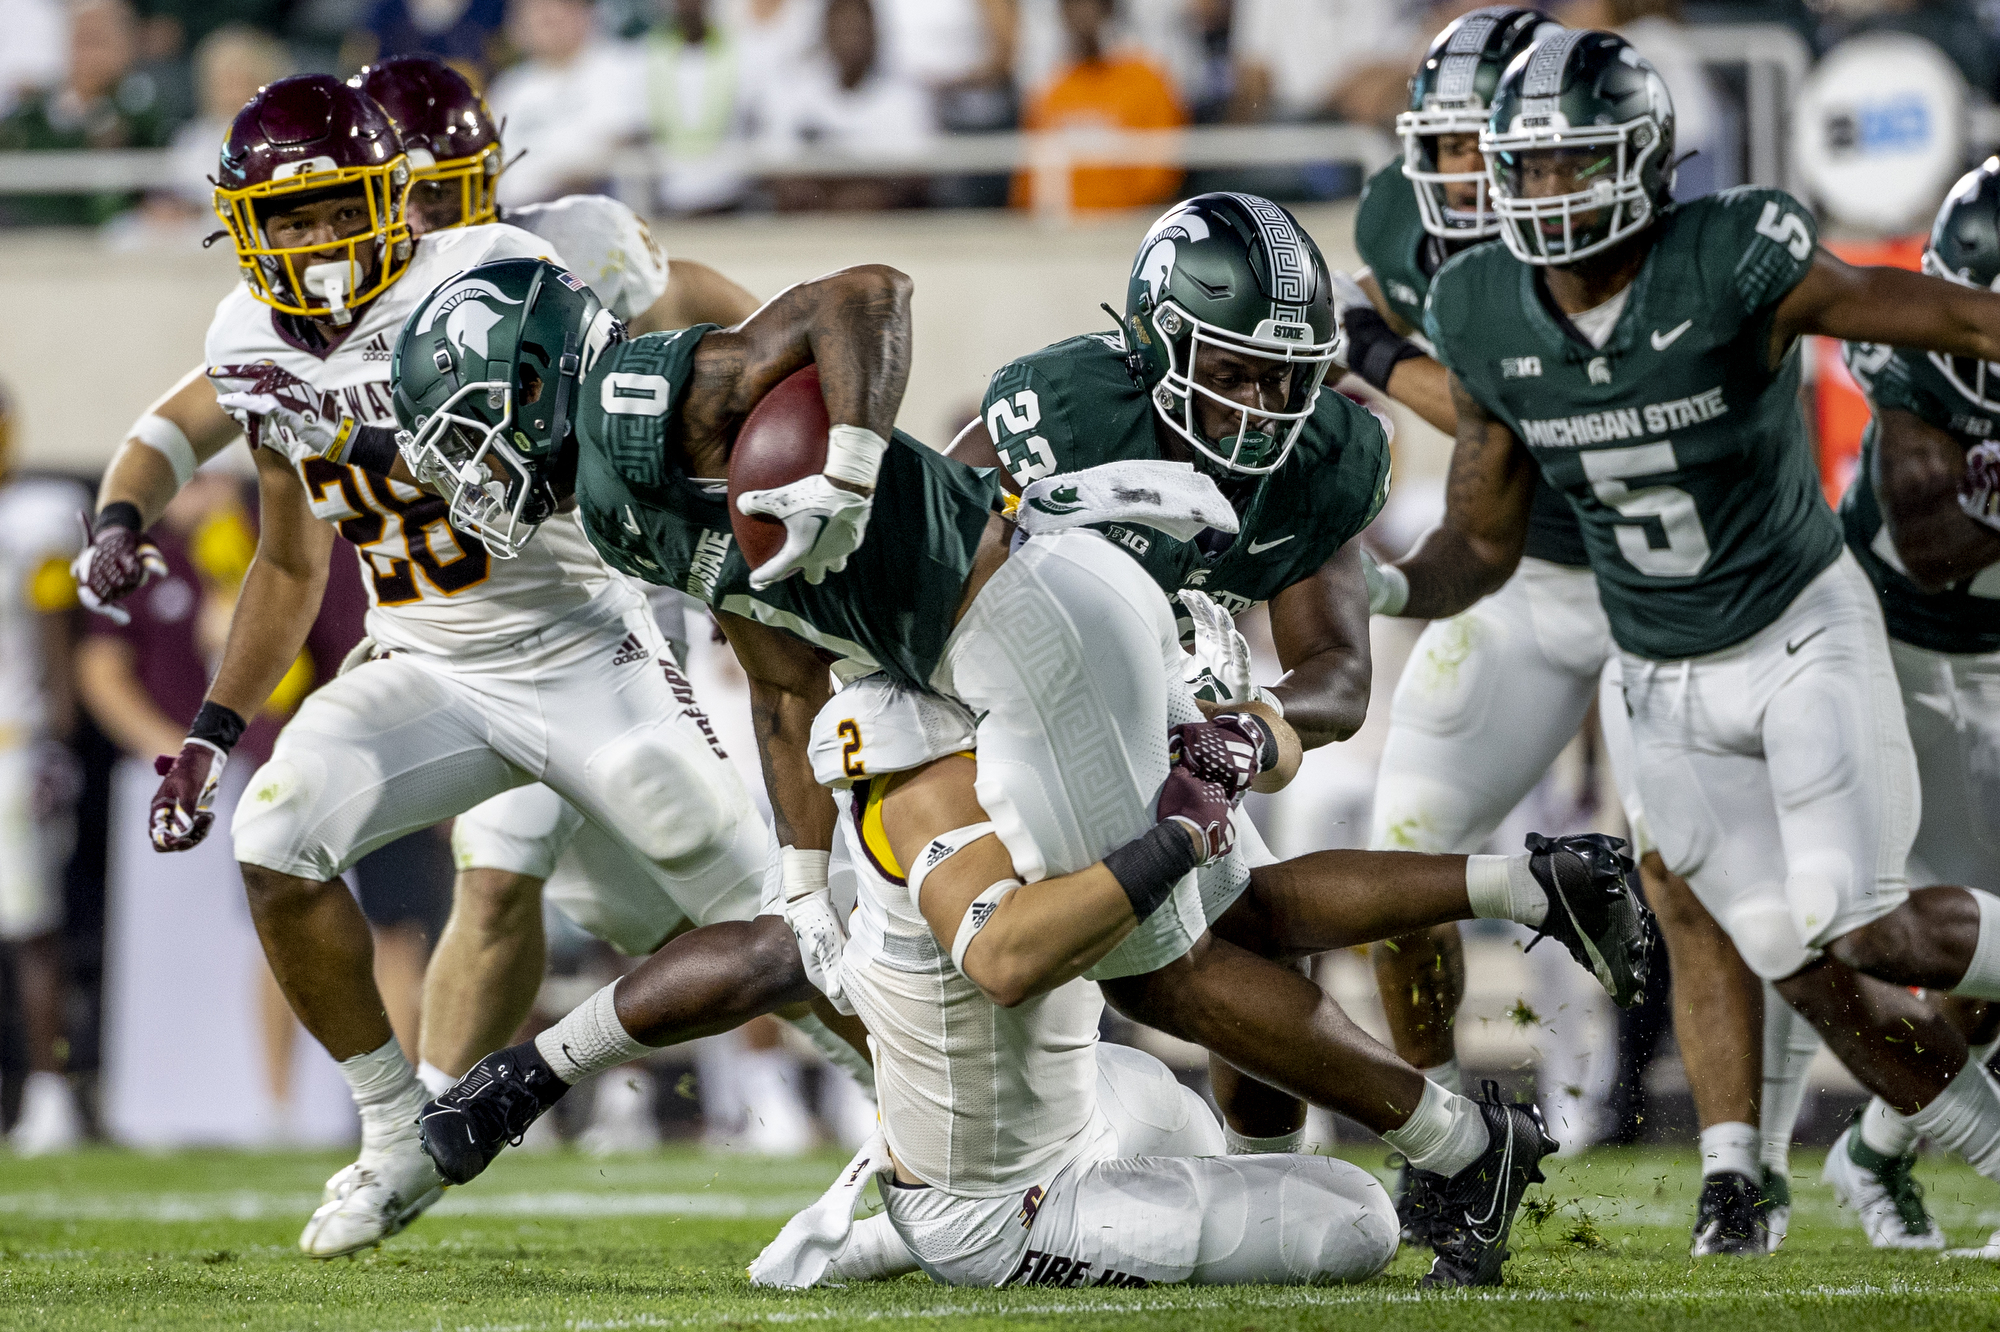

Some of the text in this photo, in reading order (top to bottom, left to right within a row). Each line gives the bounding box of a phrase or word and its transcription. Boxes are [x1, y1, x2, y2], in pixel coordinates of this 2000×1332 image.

[1755, 200, 1811, 260] 5
[1273, 325, 1305, 340] STATE
[362, 350, 392, 361] adida
[600, 372, 670, 416] 0
[987, 389, 1057, 488] 23
[1520, 386, 1729, 447] MICHIGAN STATE
[1579, 440, 1711, 577] 5
[301, 455, 491, 607] 28
[612, 649, 649, 666] adidas
[837, 718, 866, 778] 2
[926, 846, 954, 867] adidas
[973, 902, 997, 928] adidas
[1007, 1249, 1092, 1289] FIRE
